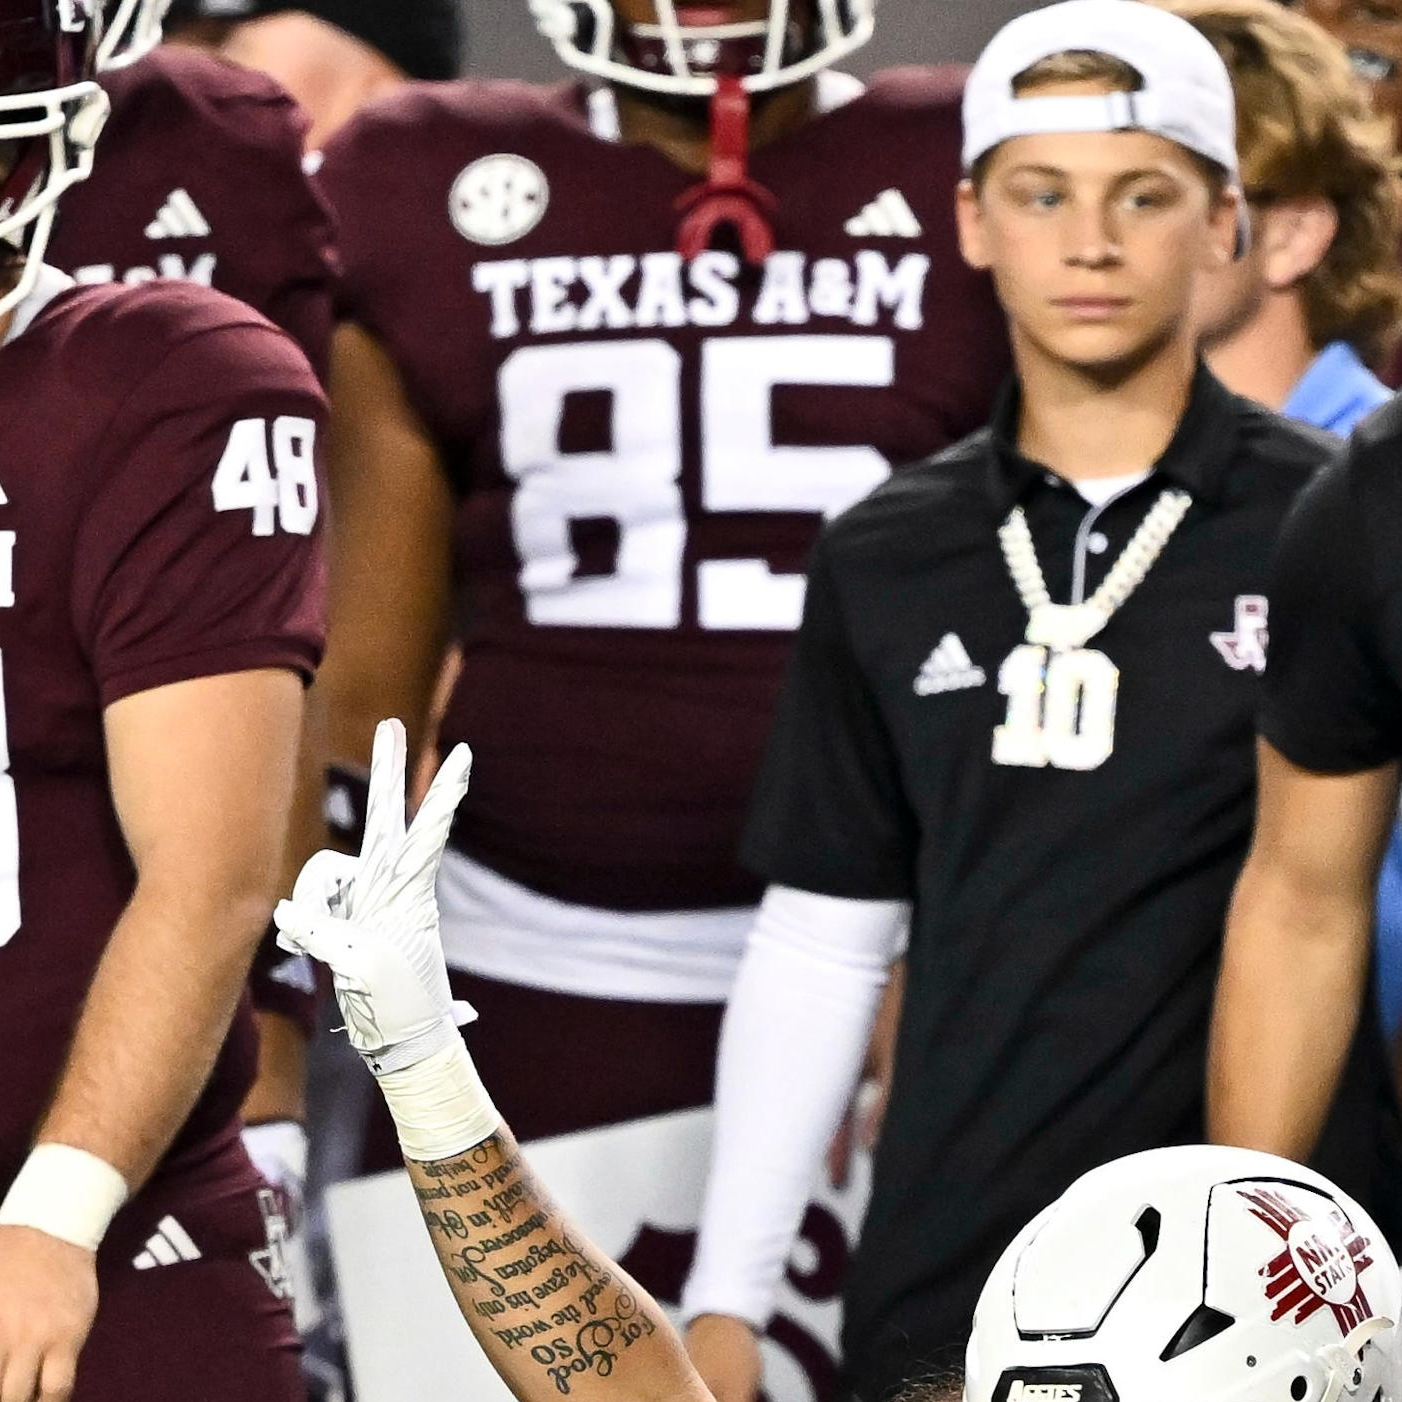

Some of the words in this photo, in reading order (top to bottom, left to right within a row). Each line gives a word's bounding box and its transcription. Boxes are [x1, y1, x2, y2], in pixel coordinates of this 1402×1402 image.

[472, 254, 738, 338] TEXAS
[753, 250, 931, 330] A&M
[211, 416, 317, 536] 48
[499, 335, 895, 629] 85
[992, 645, 1119, 770] 10
[450, 1179, 482, 1197] not
[493, 1238, 566, 1279] begotten
[505, 1291, 540, 1312] his
[531, 1267, 569, 1299] gave
[472, 1298, 506, 1322] only
[551, 1304, 582, 1325] the
[547, 1317, 621, 1395] God
